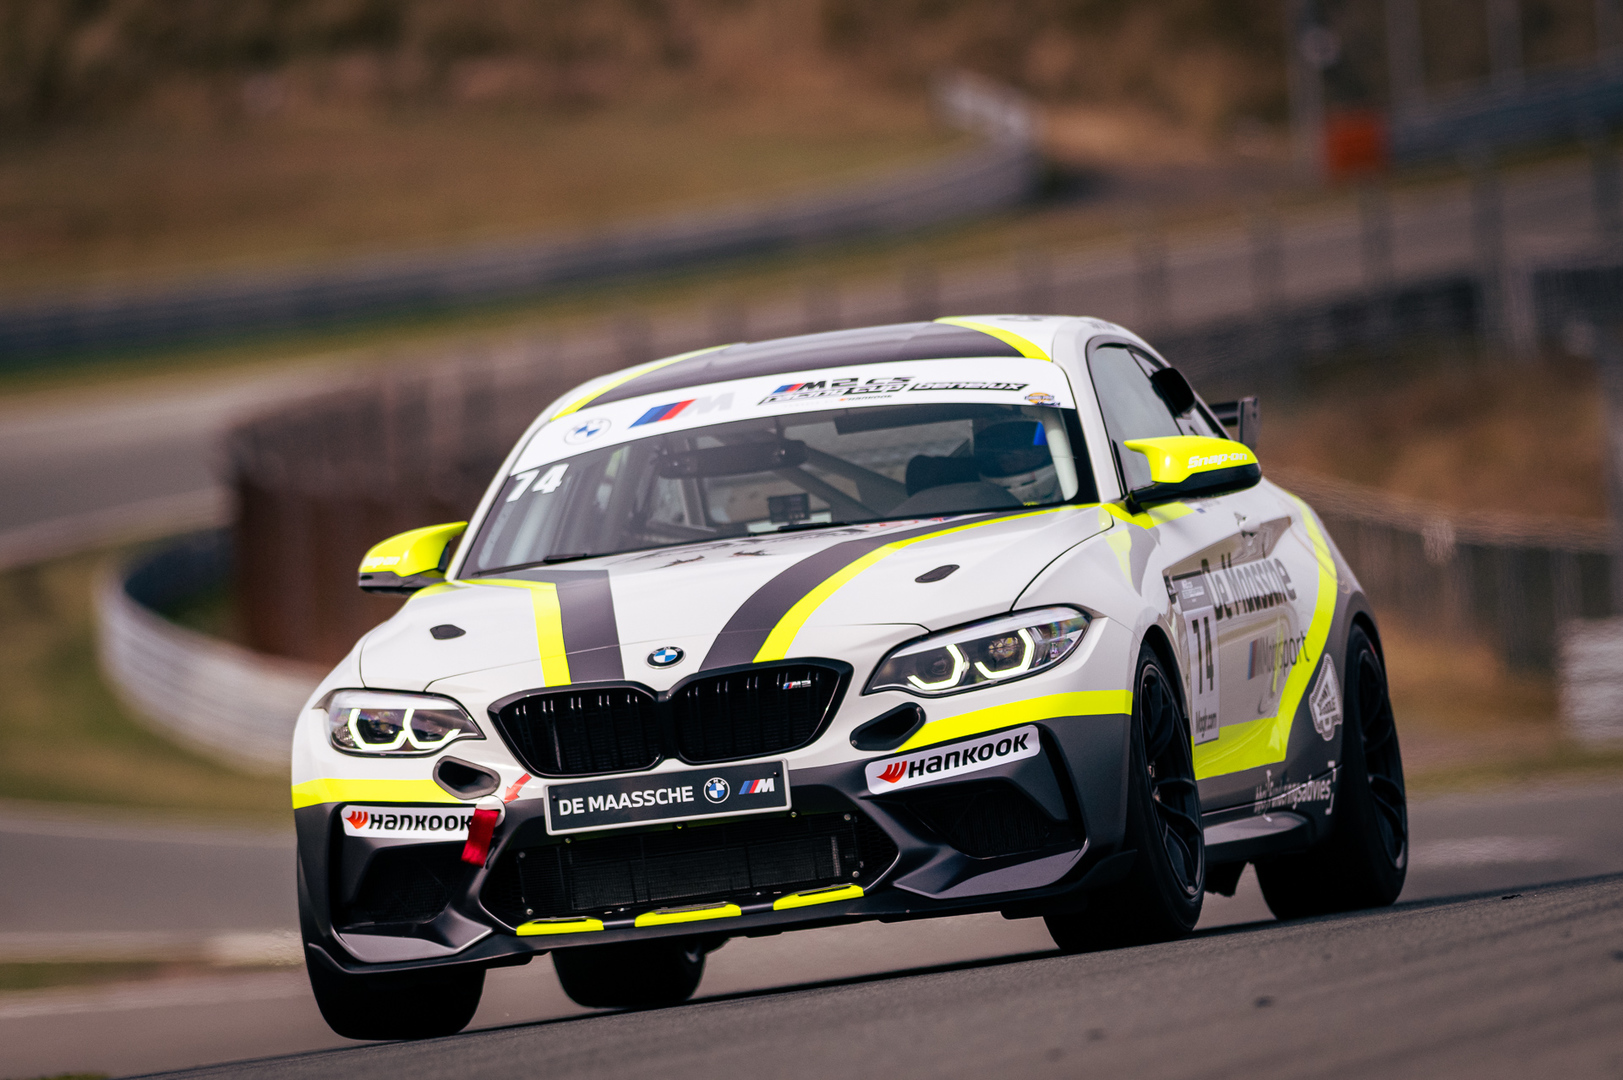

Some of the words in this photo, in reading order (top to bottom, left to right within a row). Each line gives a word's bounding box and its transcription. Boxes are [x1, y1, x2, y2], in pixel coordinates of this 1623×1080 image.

[1187, 452, 1248, 469] Snap-on
[506, 463, 570, 503] 74
[1191, 615, 1214, 695] 74
[558, 797, 586, 816] DE
[587, 785, 695, 813] MAASSCHE
